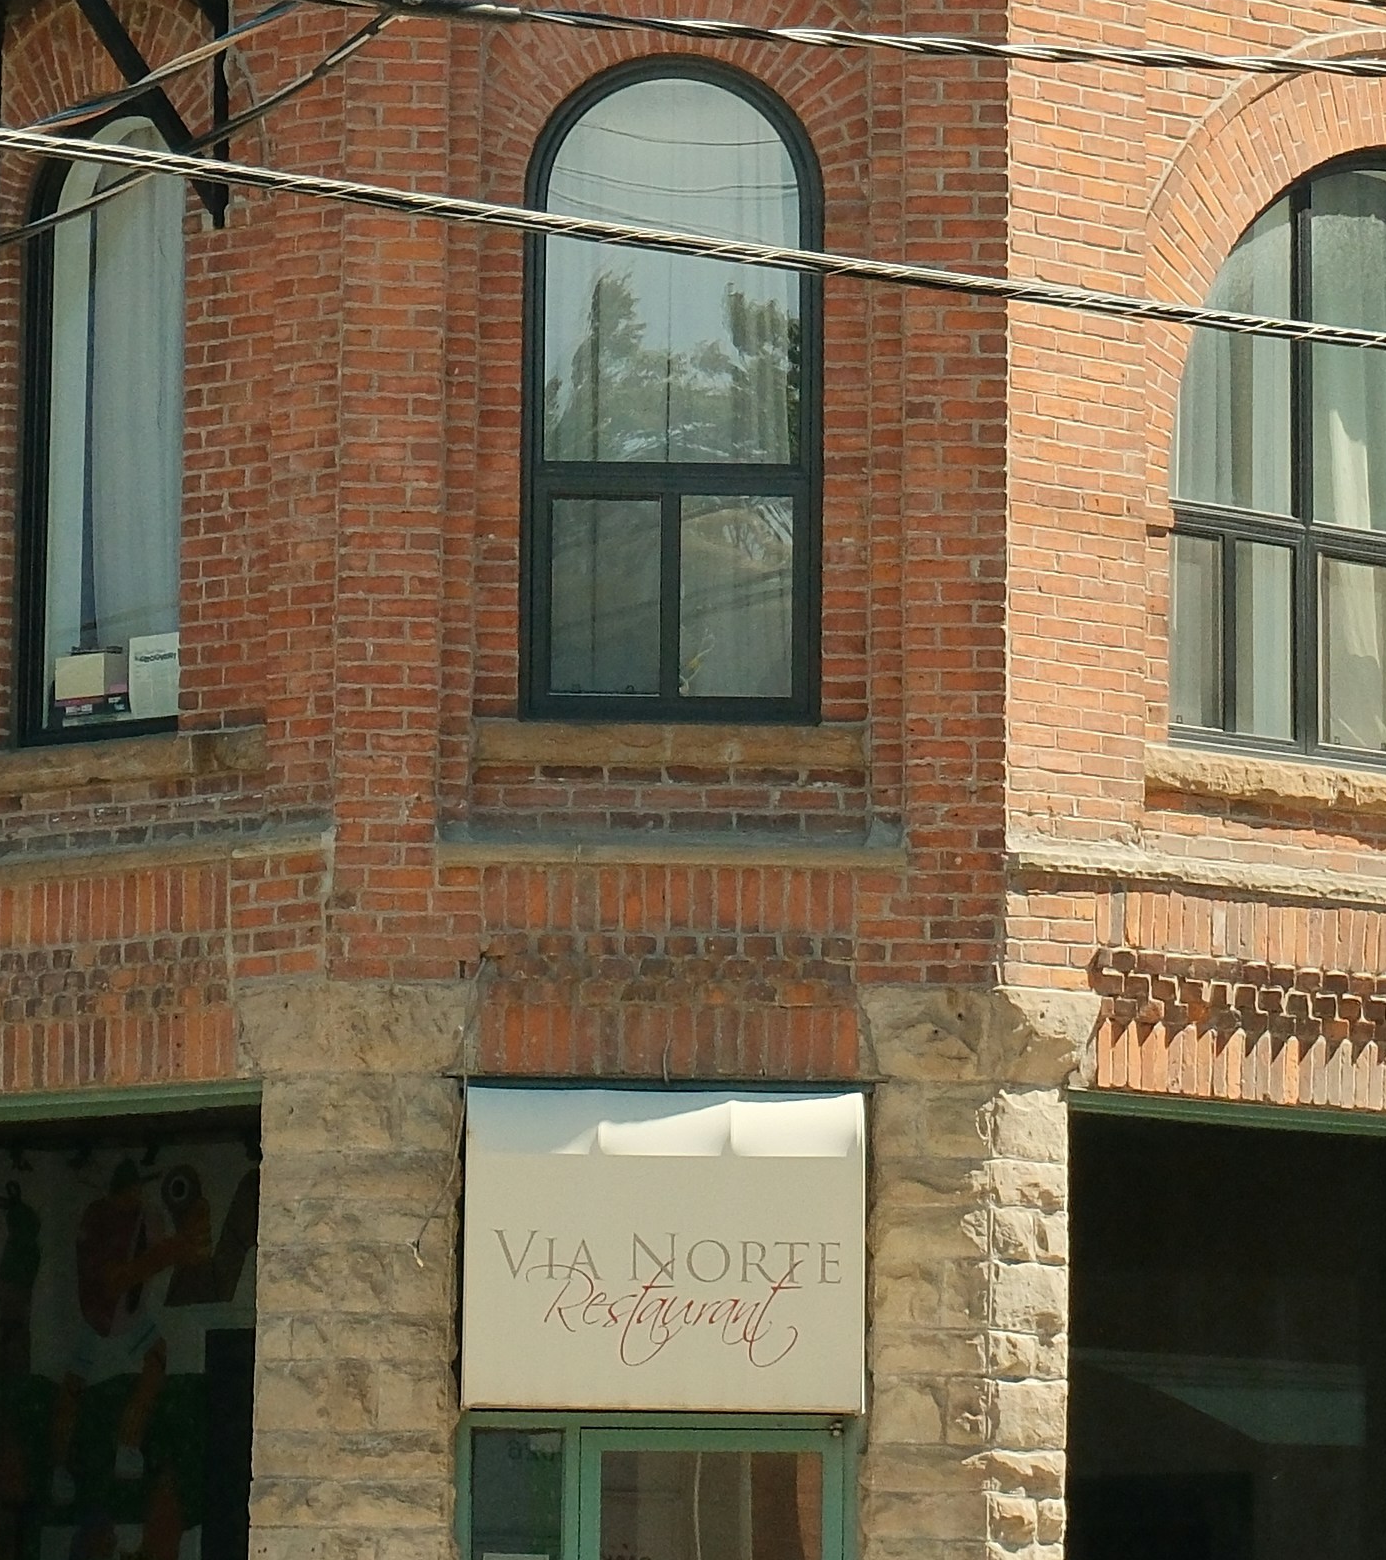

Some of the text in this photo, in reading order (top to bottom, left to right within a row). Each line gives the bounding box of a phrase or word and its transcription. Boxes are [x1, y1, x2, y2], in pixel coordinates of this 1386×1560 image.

[493, 1229, 843, 1285] VIA NORTE
[525, 1257, 804, 1368] Restaurant
